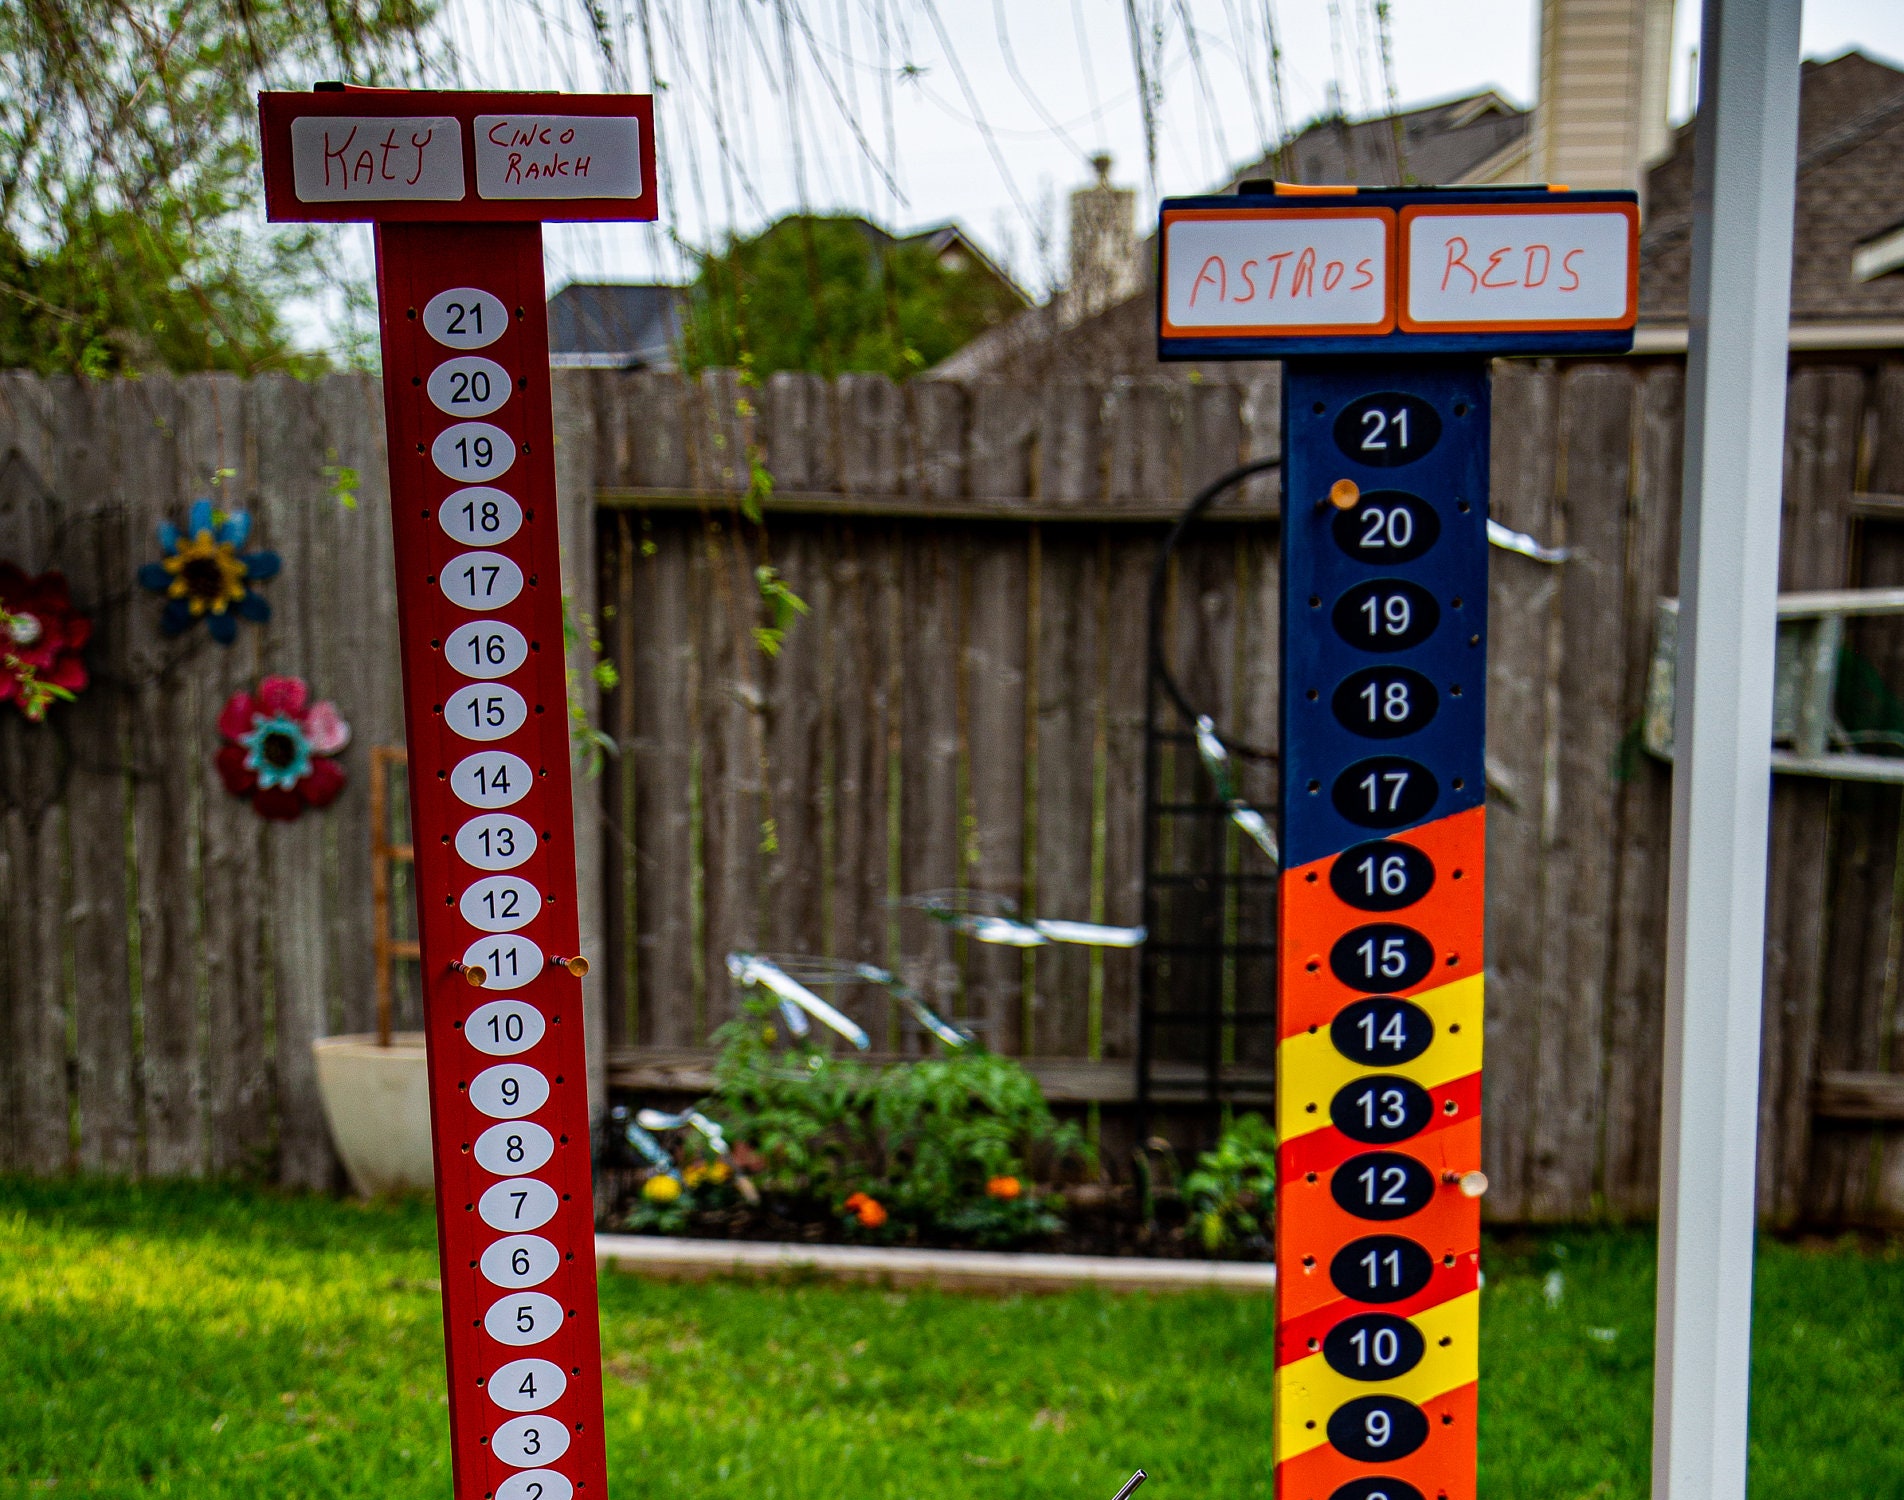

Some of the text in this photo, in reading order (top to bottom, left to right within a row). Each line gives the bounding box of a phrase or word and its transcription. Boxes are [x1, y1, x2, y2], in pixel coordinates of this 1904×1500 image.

[488, 122, 575, 147] CINCO
[505, 152, 591, 184] RANCH
[1188, 245, 1375, 309] ASTROS
[1440, 235, 1586, 294] REDS
[444, 301, 483, 335] 21
[449, 370, 491, 404] 20
[1362, 409, 1407, 448] 21
[454, 436, 494, 469] 19
[461, 501, 501, 533] 18
[1361, 508, 1412, 546] 20
[463, 565, 501, 597] 17
[1362, 596, 1409, 634] 19
[467, 634, 506, 665] 16
[467, 696, 505, 728] 15
[1362, 683, 1408, 720] 18
[473, 764, 511, 796] 14
[1361, 773, 1407, 810] 17
[478, 827, 515, 857] 13
[1359, 856, 1406, 894] 16
[482, 889, 520, 919] 12
[488, 947, 518, 977] 11
[1358, 939, 1406, 976] 15
[487, 1013, 524, 1043] 10
[1359, 1013, 1406, 1049] 14
[501, 1077, 520, 1106] 9
[1358, 1090, 1405, 1126] 13
[506, 1134, 525, 1163] 8
[1360, 1167, 1406, 1203] 12
[509, 1191, 528, 1220] 7
[511, 1248, 530, 1276] 6
[1362, 1250, 1399, 1286] 11
[516, 1305, 535, 1333] 5
[1350, 1328, 1398, 1365] 10
[518, 1371, 538, 1399] 4
[523, 1428, 541, 1456] 3
[1367, 1410, 1390, 1446] 9
